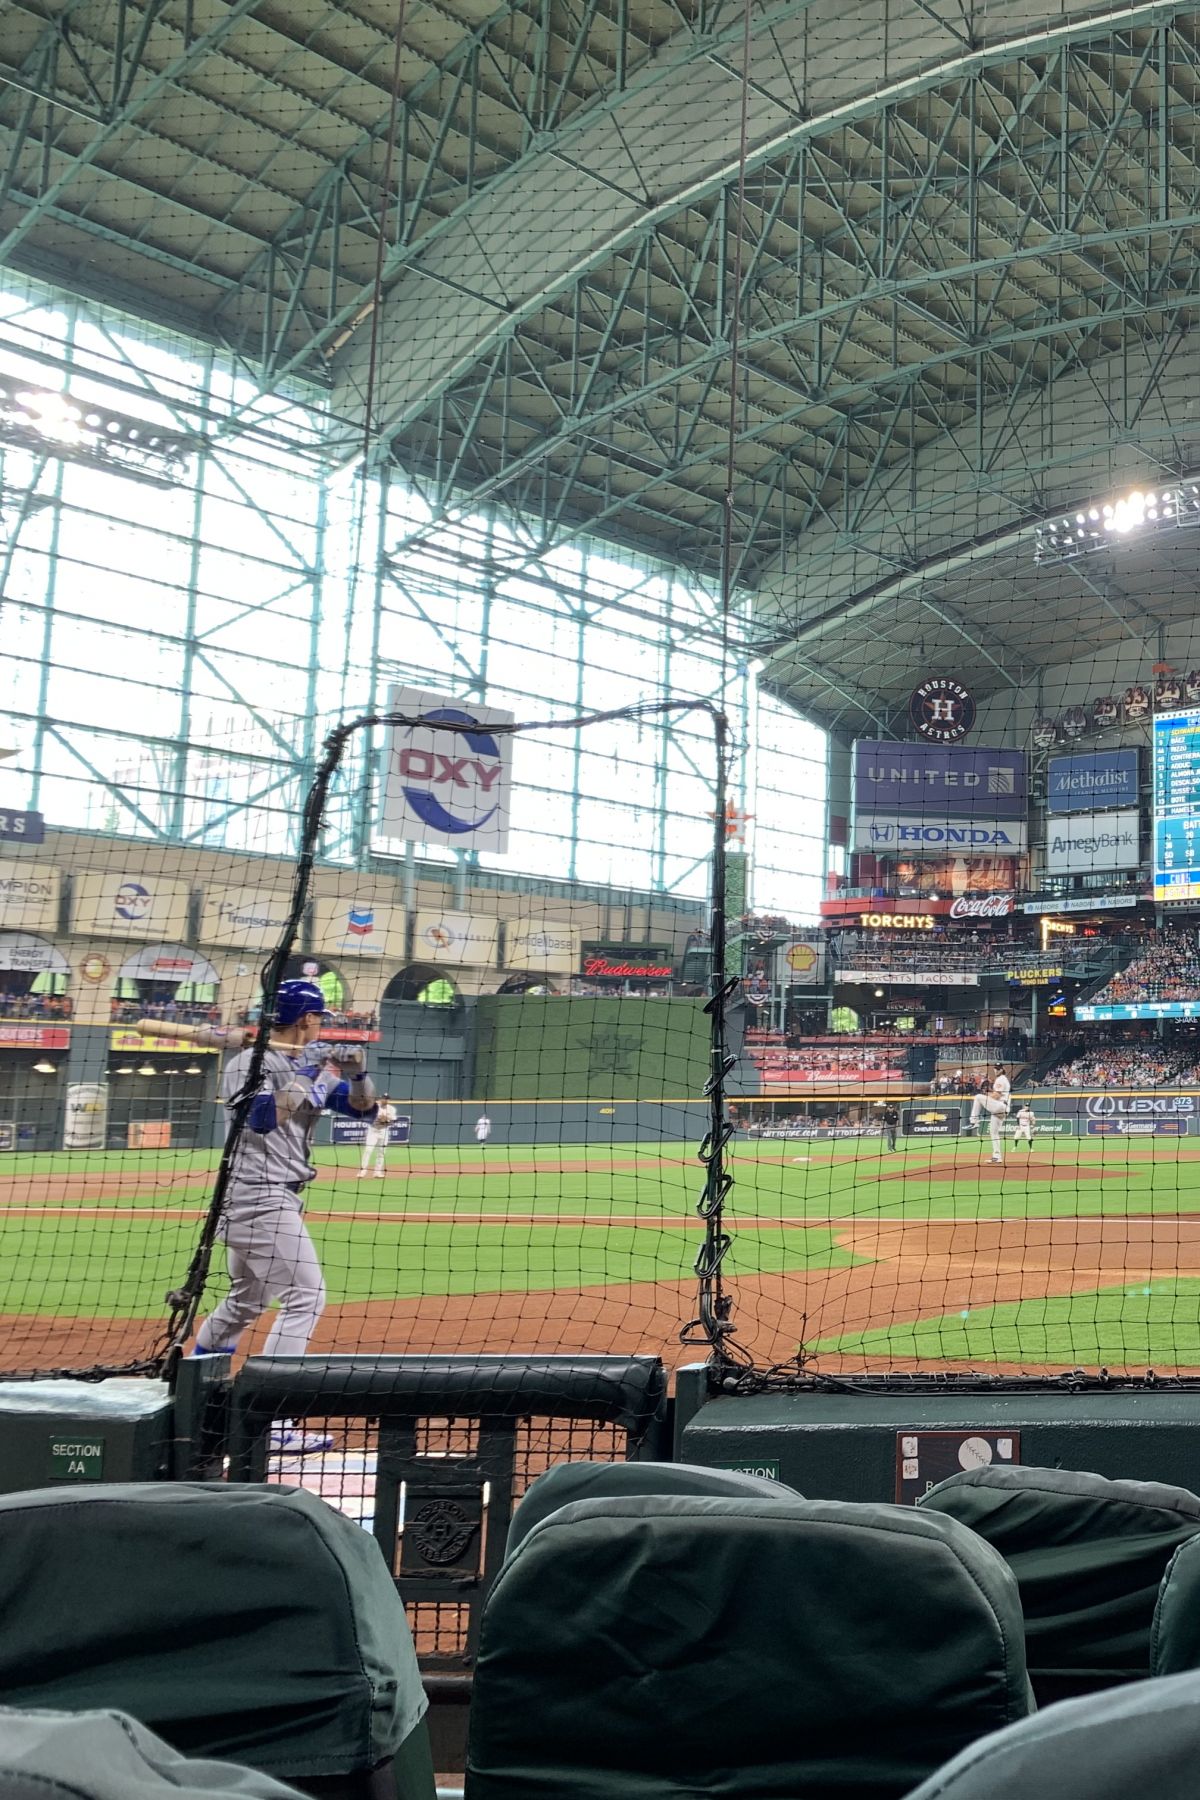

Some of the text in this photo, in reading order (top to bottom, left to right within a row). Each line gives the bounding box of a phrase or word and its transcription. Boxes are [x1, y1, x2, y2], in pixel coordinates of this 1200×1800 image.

[918, 680, 968, 699] HOUSTON
[932, 699, 954, 721] H
[920, 722, 965, 739] ASTROS
[400, 749, 503, 792] OXY
[868, 768, 980, 787] UNITED
[1056, 769, 1128, 791] Methodist
[1171, 778, 1200, 787] DESCALSO
[1171, 806, 1194, 814] HAMELS
[899, 826, 1012, 844] HONDA
[1051, 832, 1133, 854] AmegyBank
[115, 895, 150, 907] OXY
[1070, 900, 1095, 908] NABORS
[1108, 898, 1133, 906] NABORS
[10, 949, 44, 958] ENERGY
[10, 958, 53, 967] TRANSFER
[583, 958, 672, 977] Budweiser
[919, 974, 954, 983] TACOS
[1008, 968, 1063, 979] PLUCKERS
[806, 1070, 860, 1081] Budweiser
[1118, 1100, 1195, 1112] LEXUS
[1175, 1096, 1192, 1105] 373
[762, 1130, 818, 1138] NITTOTIRE.COM
[52, 1444, 100, 1457] SECTION
[68, 1461, 86, 1474] AA
